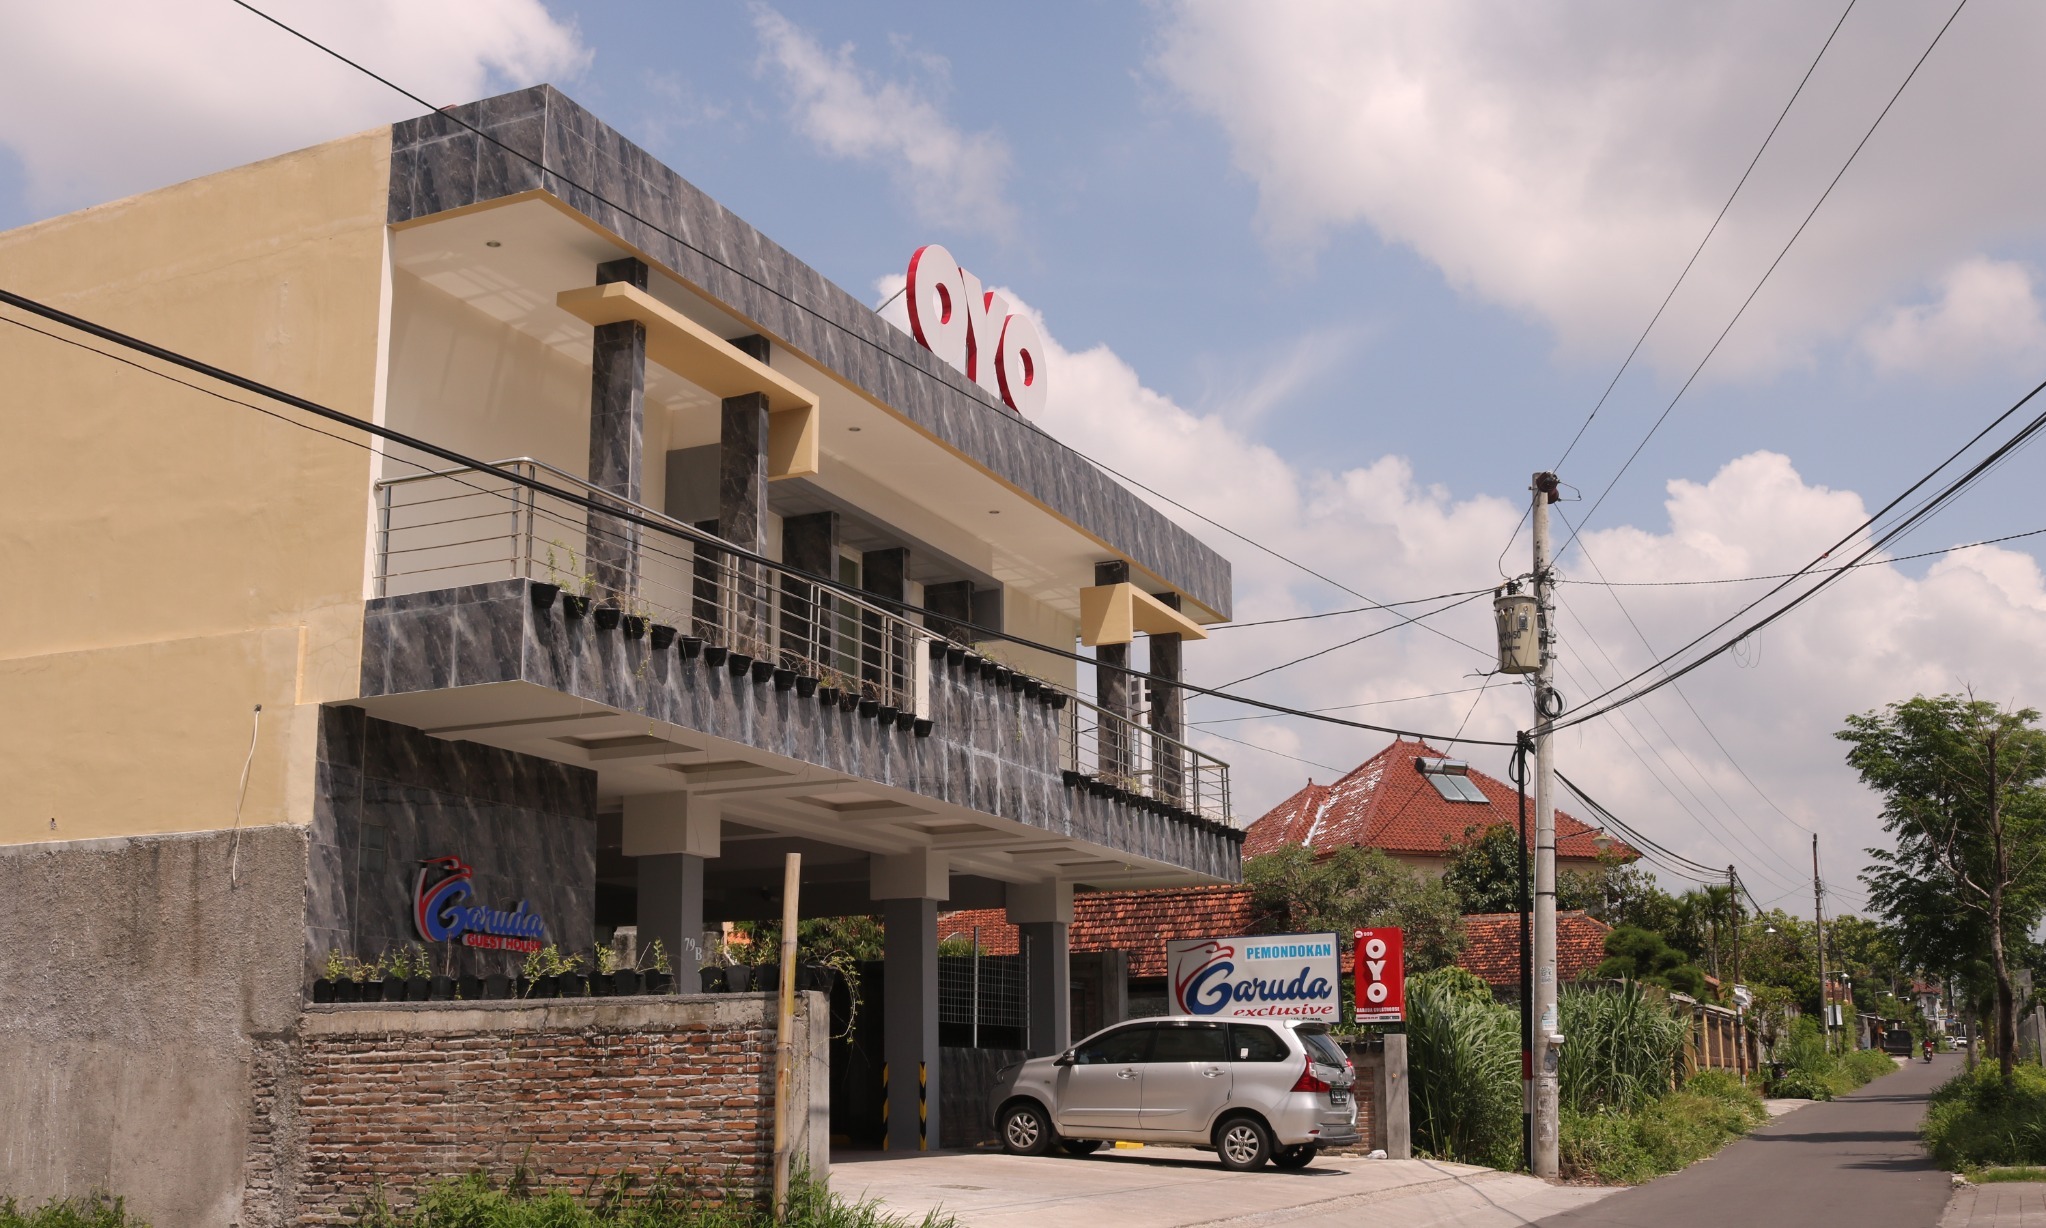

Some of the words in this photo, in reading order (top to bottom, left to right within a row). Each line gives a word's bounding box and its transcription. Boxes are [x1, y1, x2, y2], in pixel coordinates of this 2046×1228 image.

[906, 244, 1047, 422] OYO
[426, 880, 545, 942] Garuda
[467, 934, 502, 950] GUEST
[684, 937, 695, 952] 79
[695, 947, 703, 961] B
[1246, 943, 1332, 960] PEMONDOKAN
[1186, 961, 1332, 1015] Garuda
[1365, 938, 1388, 1003] OYO
[1233, 1003, 1333, 1017] exclusive
